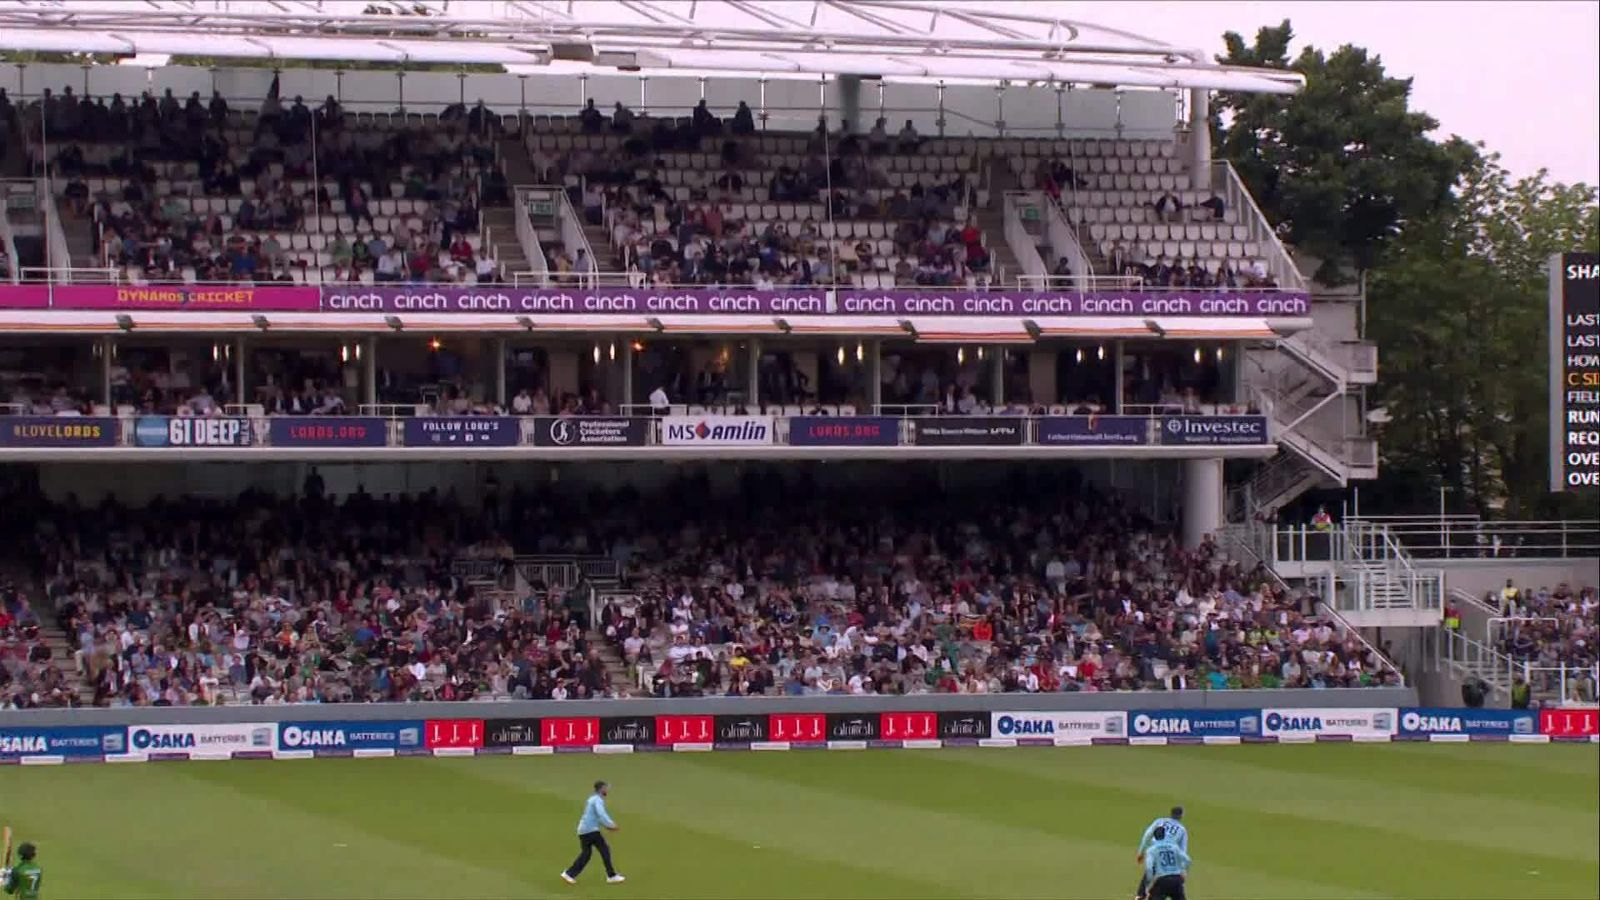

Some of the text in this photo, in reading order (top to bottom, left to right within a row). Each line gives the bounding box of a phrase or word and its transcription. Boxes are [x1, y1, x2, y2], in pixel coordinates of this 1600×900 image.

[118, 289, 254, 303] DYNAMOS CRICKET
[330, 293, 821, 311] cinch cinch cinch cinch cinch cinch cinch cinch
[844, 296, 1072, 312] cinch cinch cinch cinch
[1084, 296, 1306, 312] cinch cinch cinch cinch
[1568, 372, 1579, 386] C
[169, 419, 191, 444] 61
[195, 418, 240, 444] DEEP
[423, 421, 461, 431] FOLLOW
[668, 421, 767, 440] MS amlin
[1185, 419, 1260, 434] Investec
[997, 715, 1055, 735] OSAKA
[1134, 714, 1191, 734] OSAKA
[1266, 712, 1322, 731] OSAKA
[1402, 712, 1462, 731] OSAKA
[0, 735, 48, 752] SAKA
[132, 729, 196, 749] OSAKA
[283, 726, 346, 746] OSAKA
